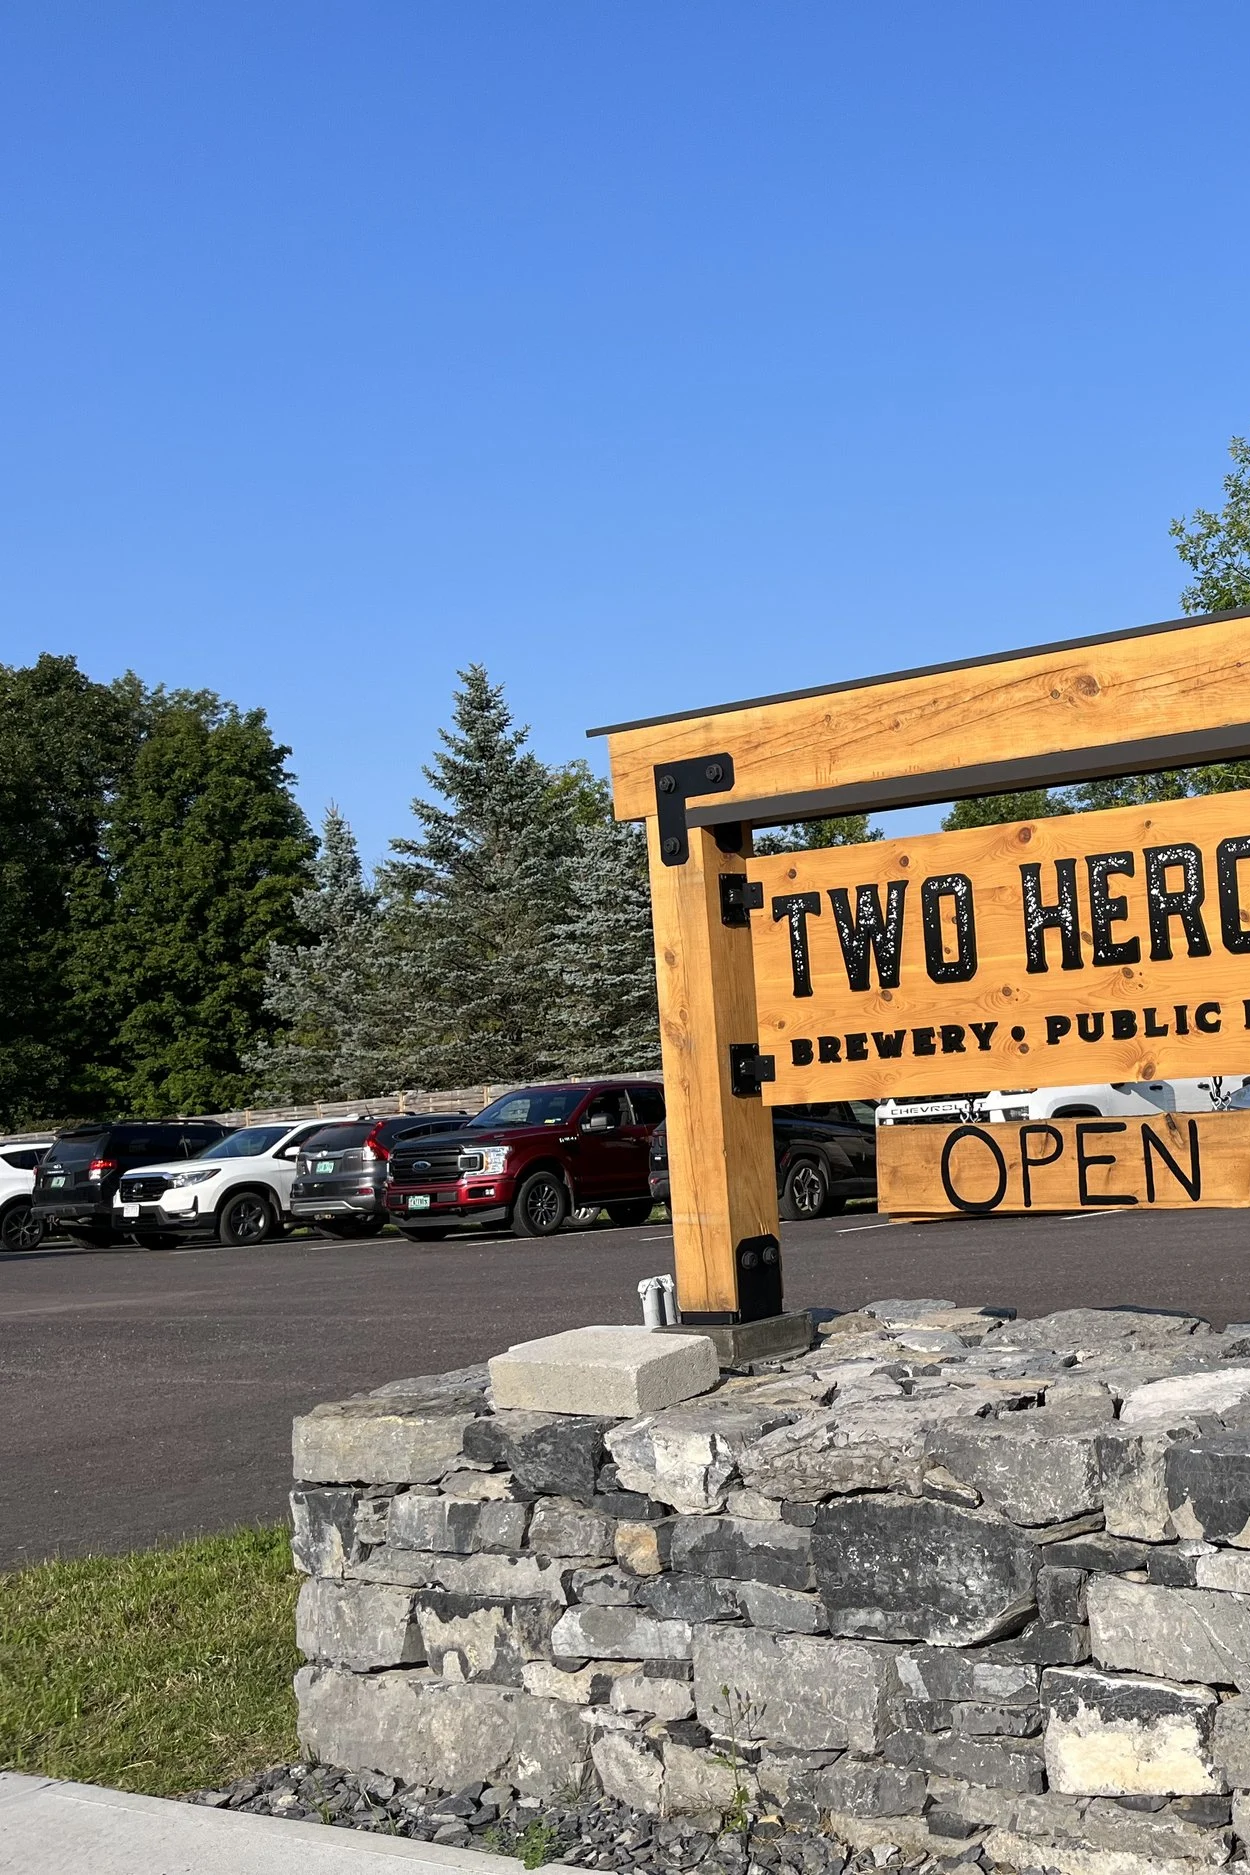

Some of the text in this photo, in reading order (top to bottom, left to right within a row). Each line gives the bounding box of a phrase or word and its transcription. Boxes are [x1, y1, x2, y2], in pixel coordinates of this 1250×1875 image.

[772, 872, 978, 998] TWO
[790, 1020, 999, 1067] BREWERY
[1045, 1001, 1222, 1045] PUBLIC
[941, 1118, 1202, 1213] OPEN
